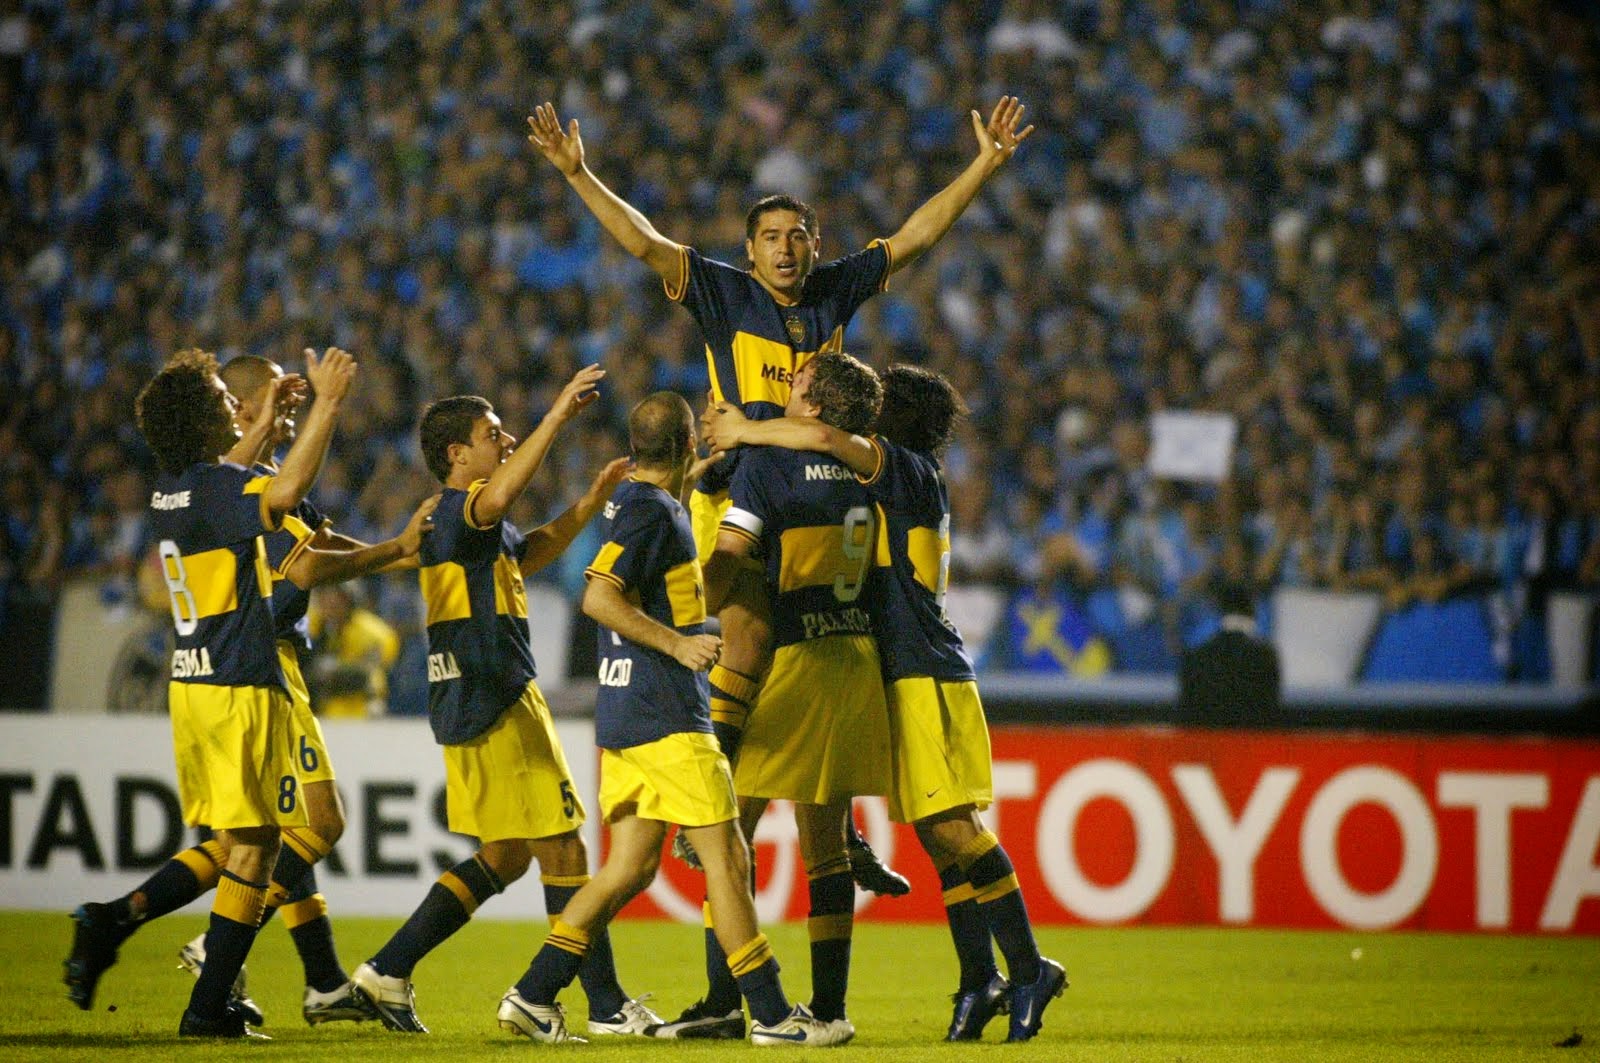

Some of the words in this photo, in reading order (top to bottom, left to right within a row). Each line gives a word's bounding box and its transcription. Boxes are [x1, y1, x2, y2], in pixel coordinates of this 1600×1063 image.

[762, 363, 794, 383] MEG
[805, 465, 857, 481] MEGA
[834, 506, 874, 602] 9
[159, 540, 198, 635] 8
[300, 735, 318, 772] 6
[278, 774, 296, 813] 8
[559, 779, 576, 819] 5
